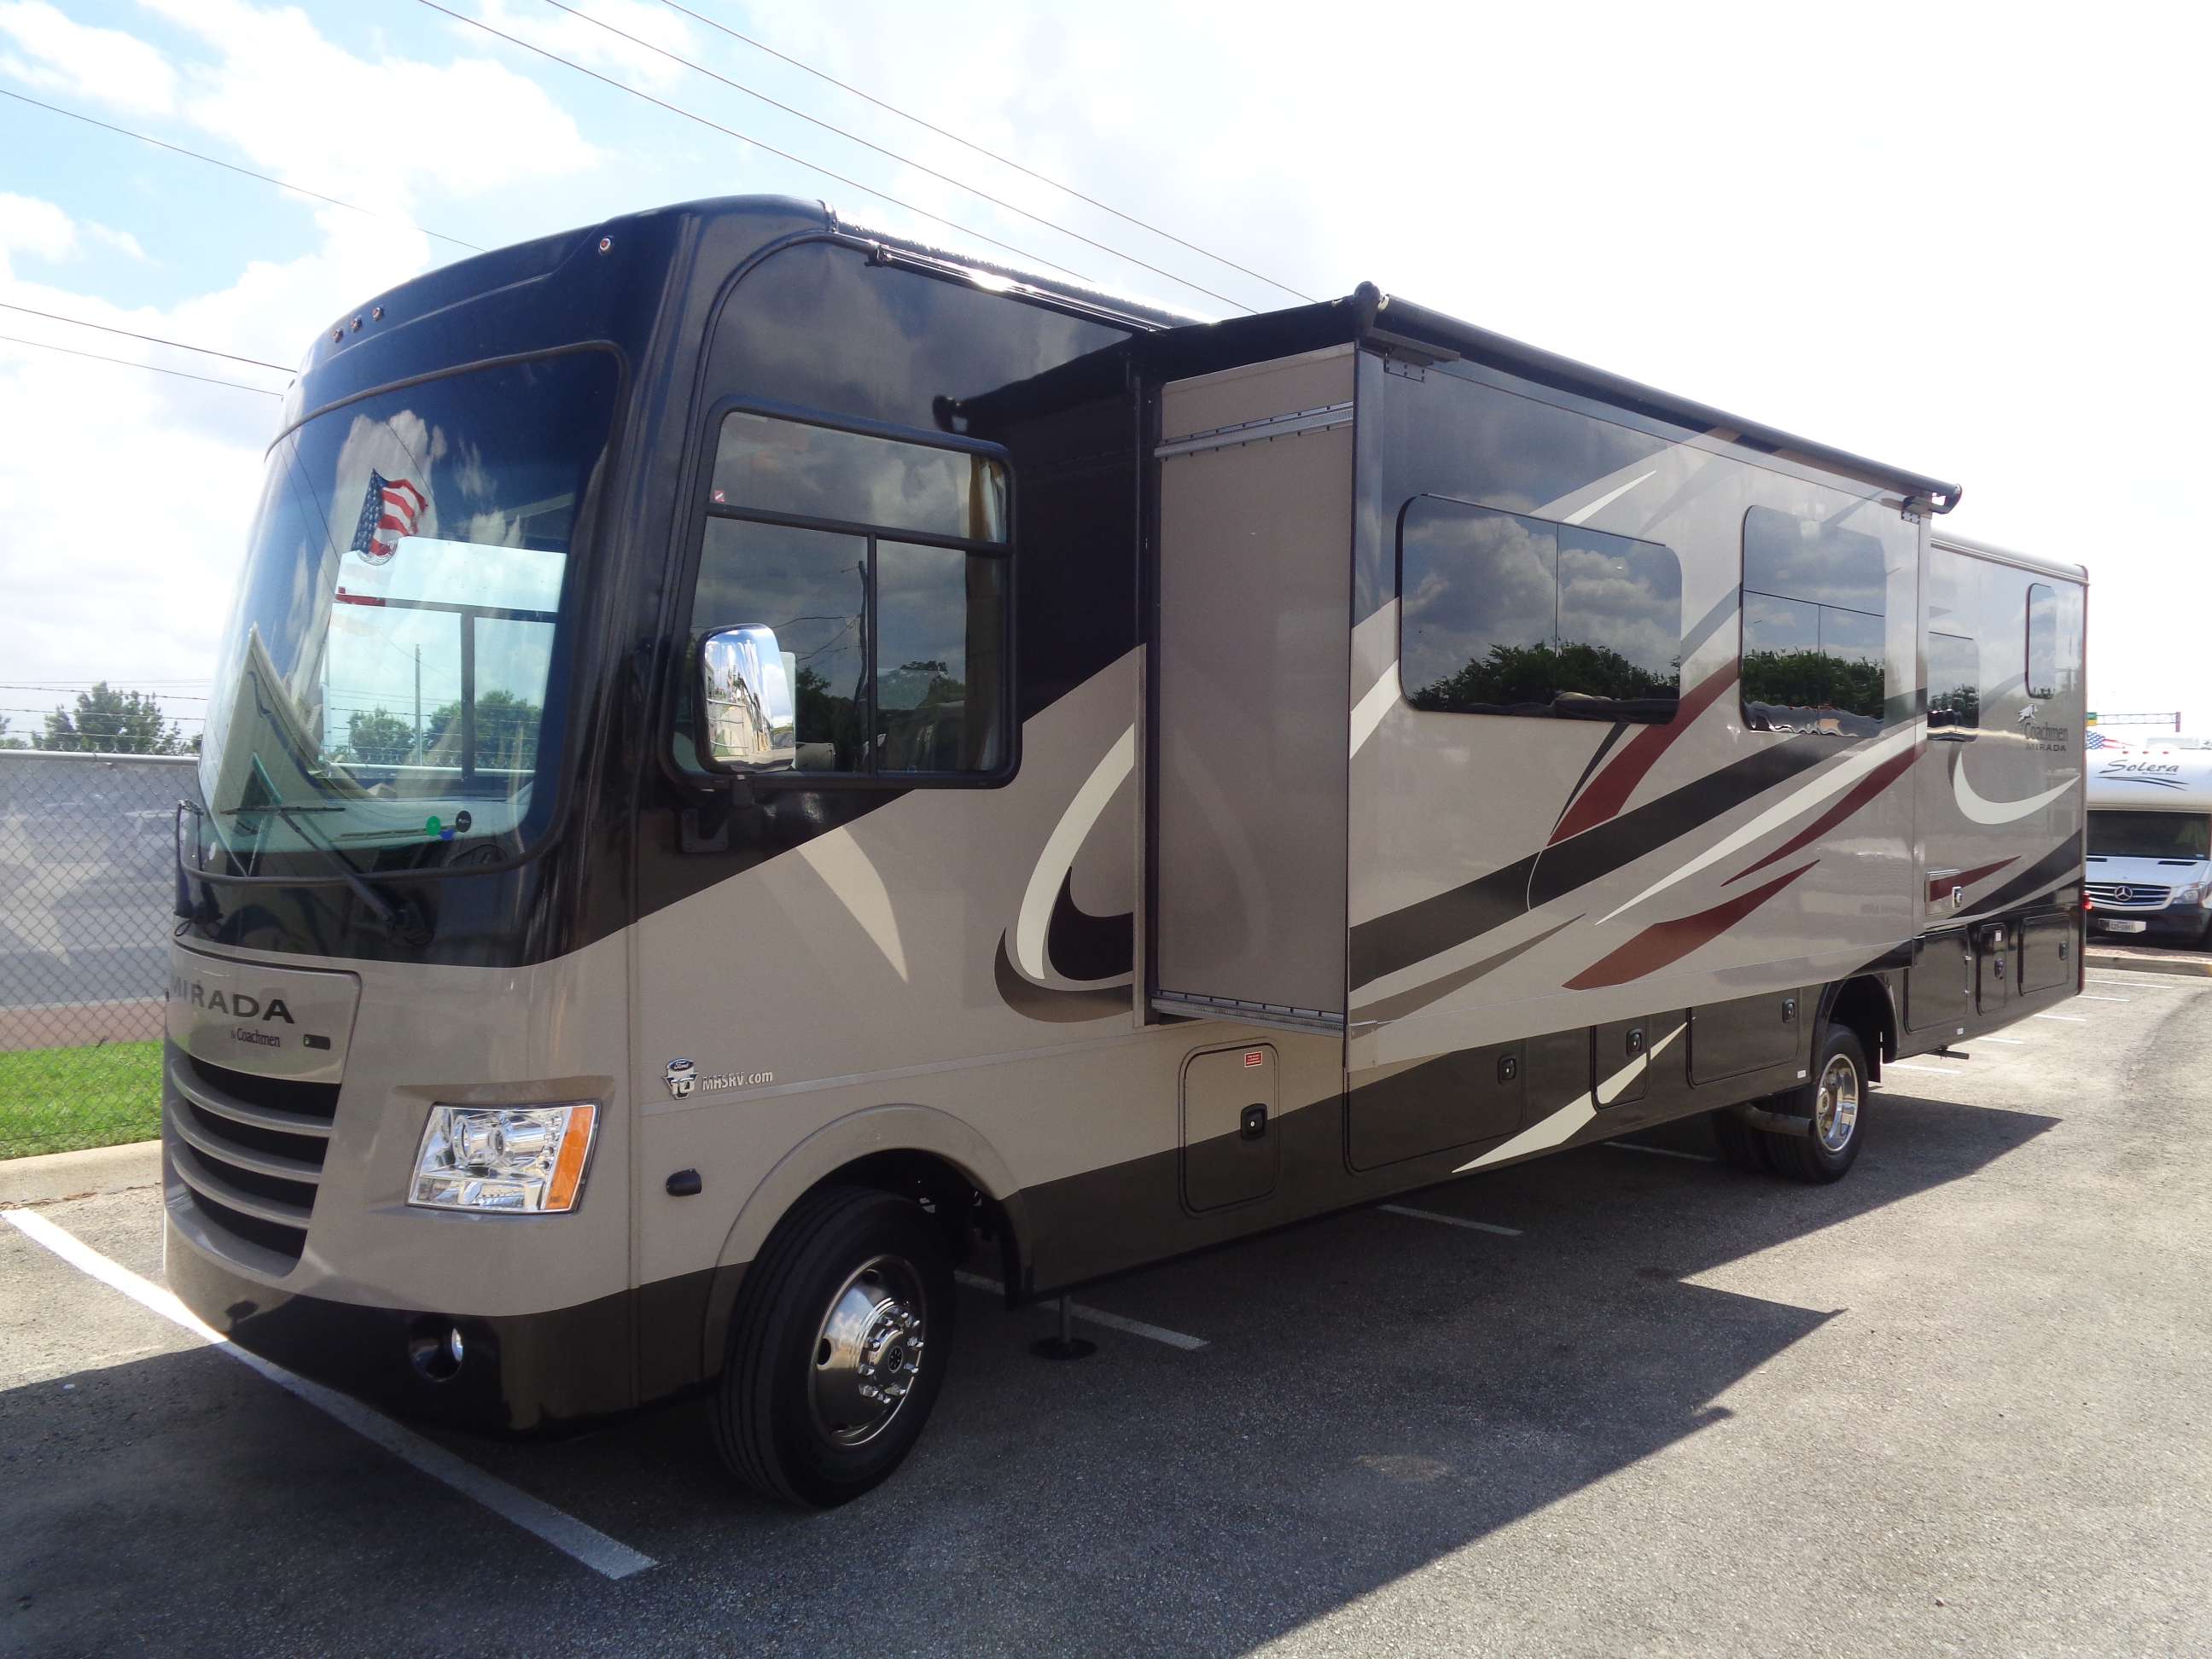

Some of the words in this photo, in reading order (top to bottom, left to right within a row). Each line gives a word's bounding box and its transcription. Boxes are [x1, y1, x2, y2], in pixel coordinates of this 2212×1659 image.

[2098, 759, 2180, 774] Solera
[237, 1027, 280, 1047] Coachmen
[702, 1071, 773, 1091] MHSRV.com
